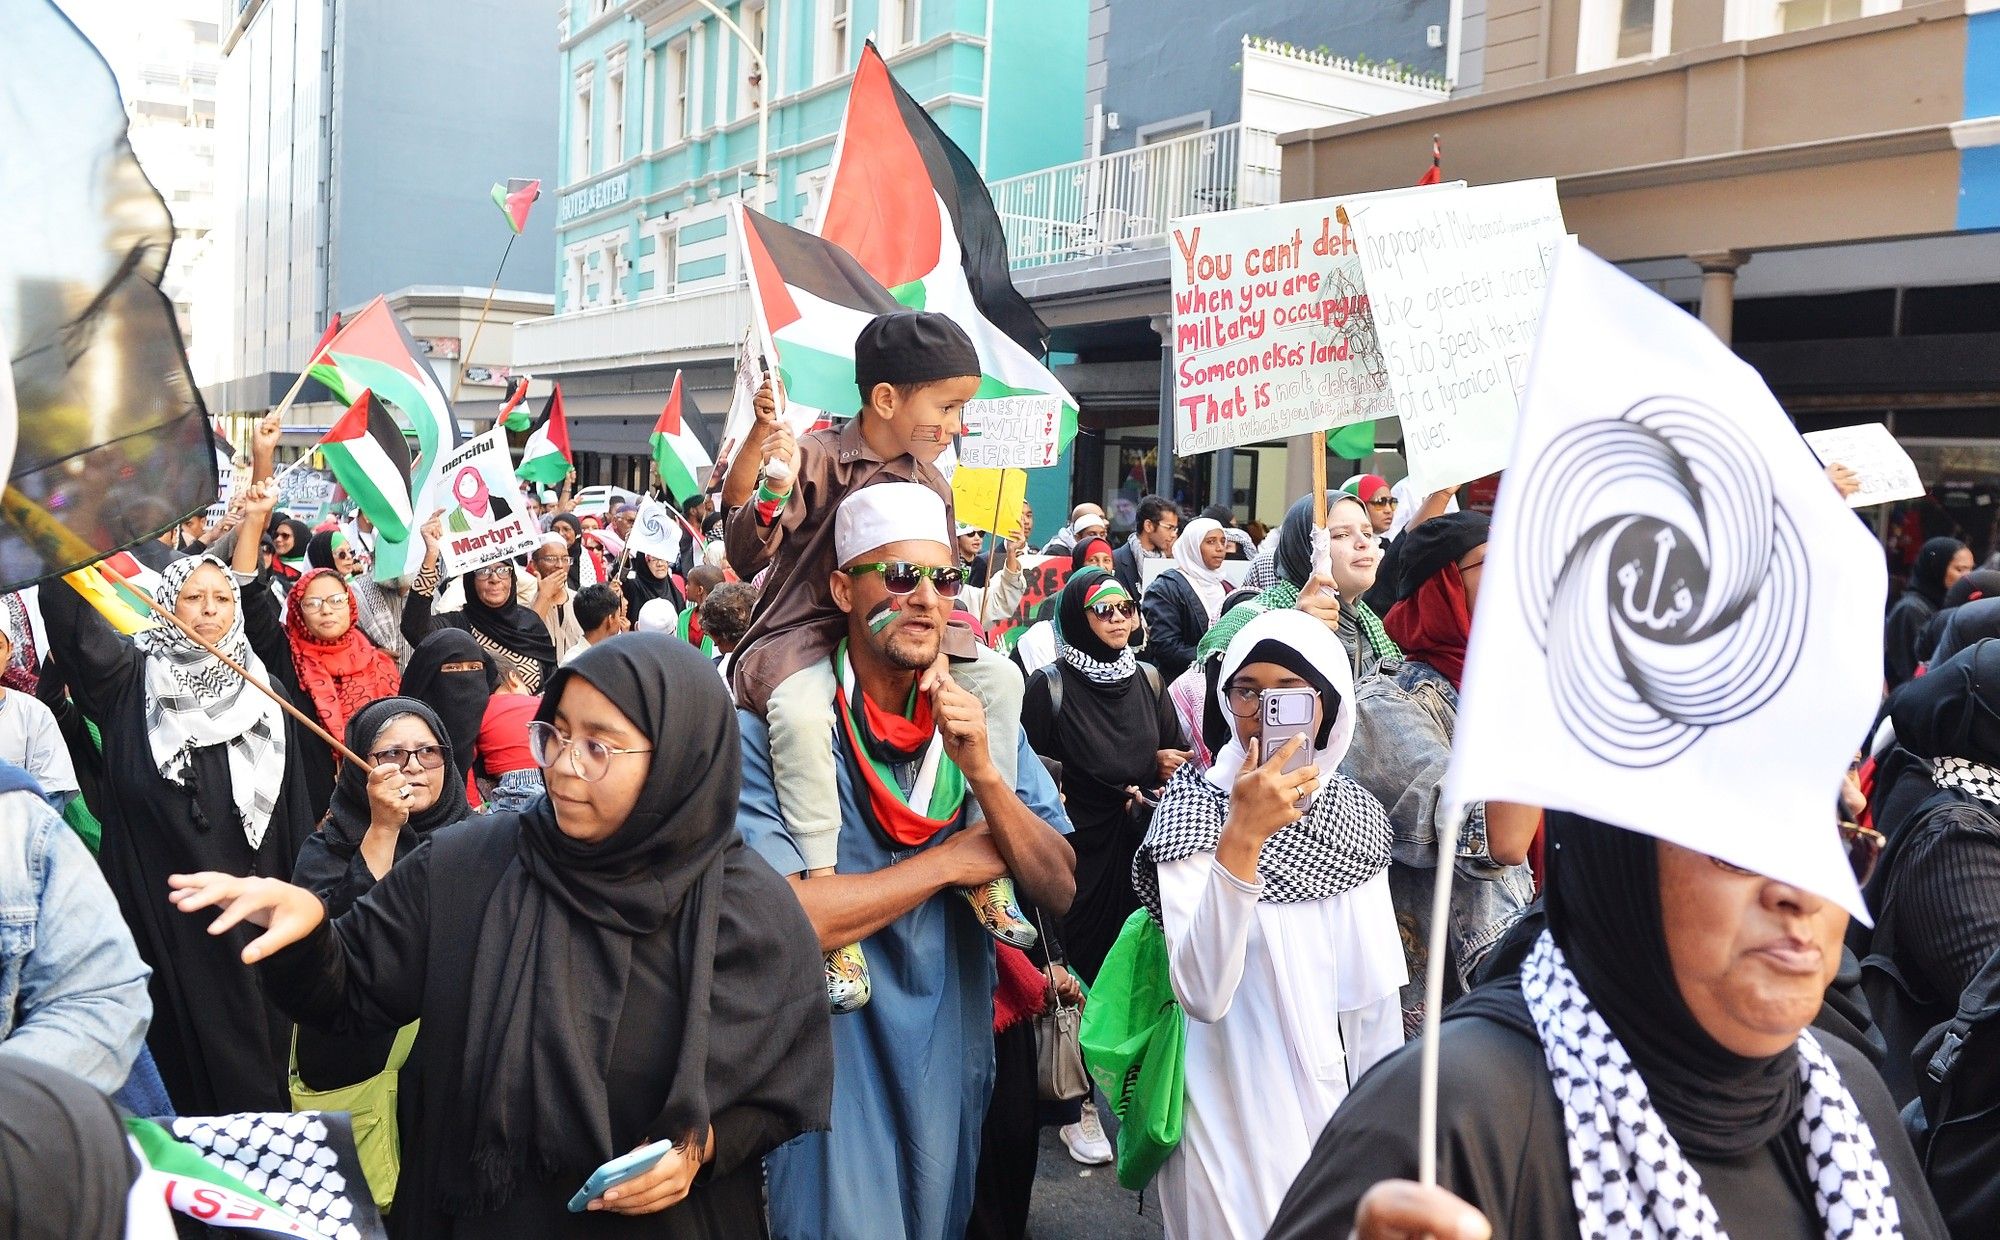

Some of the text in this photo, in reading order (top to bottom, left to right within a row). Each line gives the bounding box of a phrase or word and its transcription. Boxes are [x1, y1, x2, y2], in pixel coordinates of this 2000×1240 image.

[562, 188, 589, 220] HOTEL
[595, 172, 629, 210] EATERY
[1173, 216, 1359, 286] You can't def
[1175, 271, 1320, 316] when you are
[1272, 294, 1370, 328] occupyin
[1372, 292, 1422, 329] the
[1426, 271, 1493, 333] greatest
[1408, 334, 1435, 374] to
[1439, 318, 1490, 378] speak
[1487, 313, 1516, 349] the
[965, 399, 1057, 417] PALESTINE
[1179, 386, 1248, 432] That
[1254, 382, 1272, 410] is
[1275, 370, 1315, 403] not
[1400, 374, 1419, 421] of
[1422, 387, 1434, 412] a
[983, 416, 1050, 444] WILL
[1181, 426, 1220, 452] call
[1239, 413, 1280, 439] what
[1280, 406, 1310, 430] you
[441, 437, 494, 475] merciful
[451, 520, 524, 556] Martyr!
